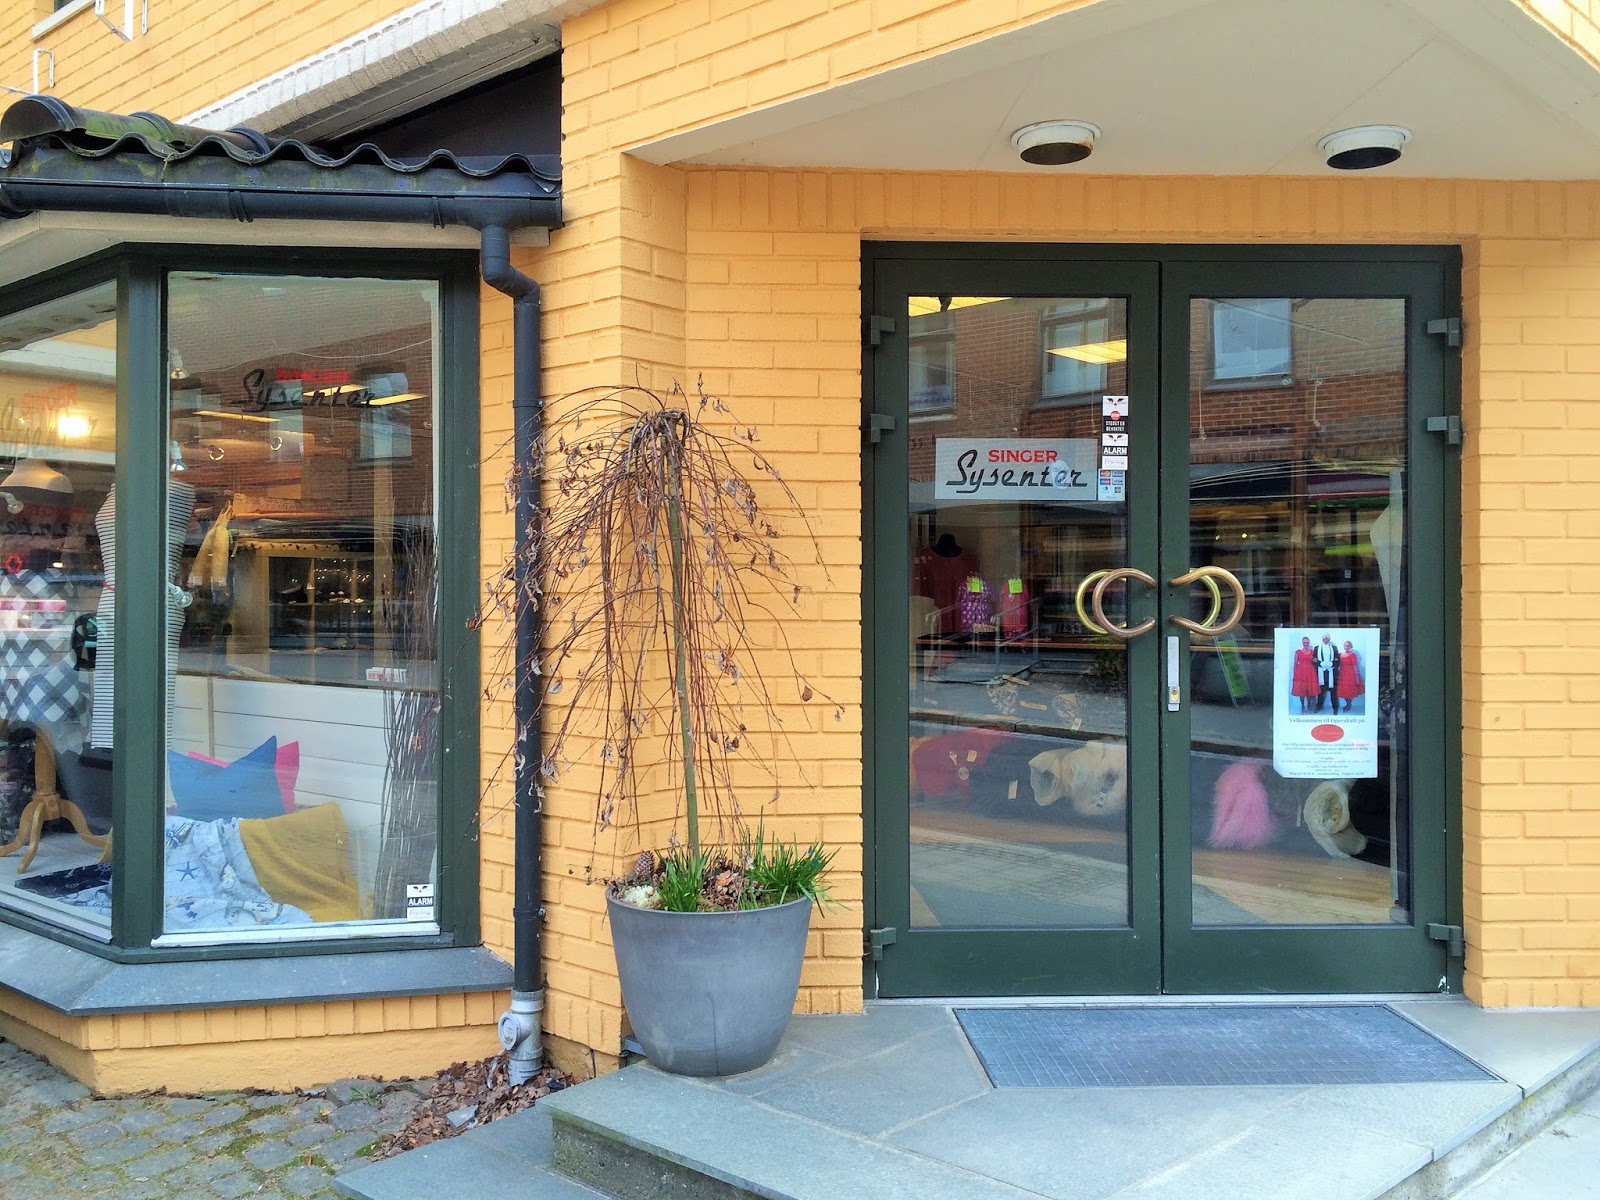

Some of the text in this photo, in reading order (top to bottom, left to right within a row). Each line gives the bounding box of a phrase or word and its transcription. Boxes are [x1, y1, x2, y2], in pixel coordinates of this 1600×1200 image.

[275, 367, 350, 384] SINGER
[230, 368, 379, 413] Sysenter
[988, 449, 1058, 462] SINGER
[1103, 447, 1127, 455] ALARM
[945, 449, 1088, 493] Sysenter
[409, 898, 433, 906] ALARM
